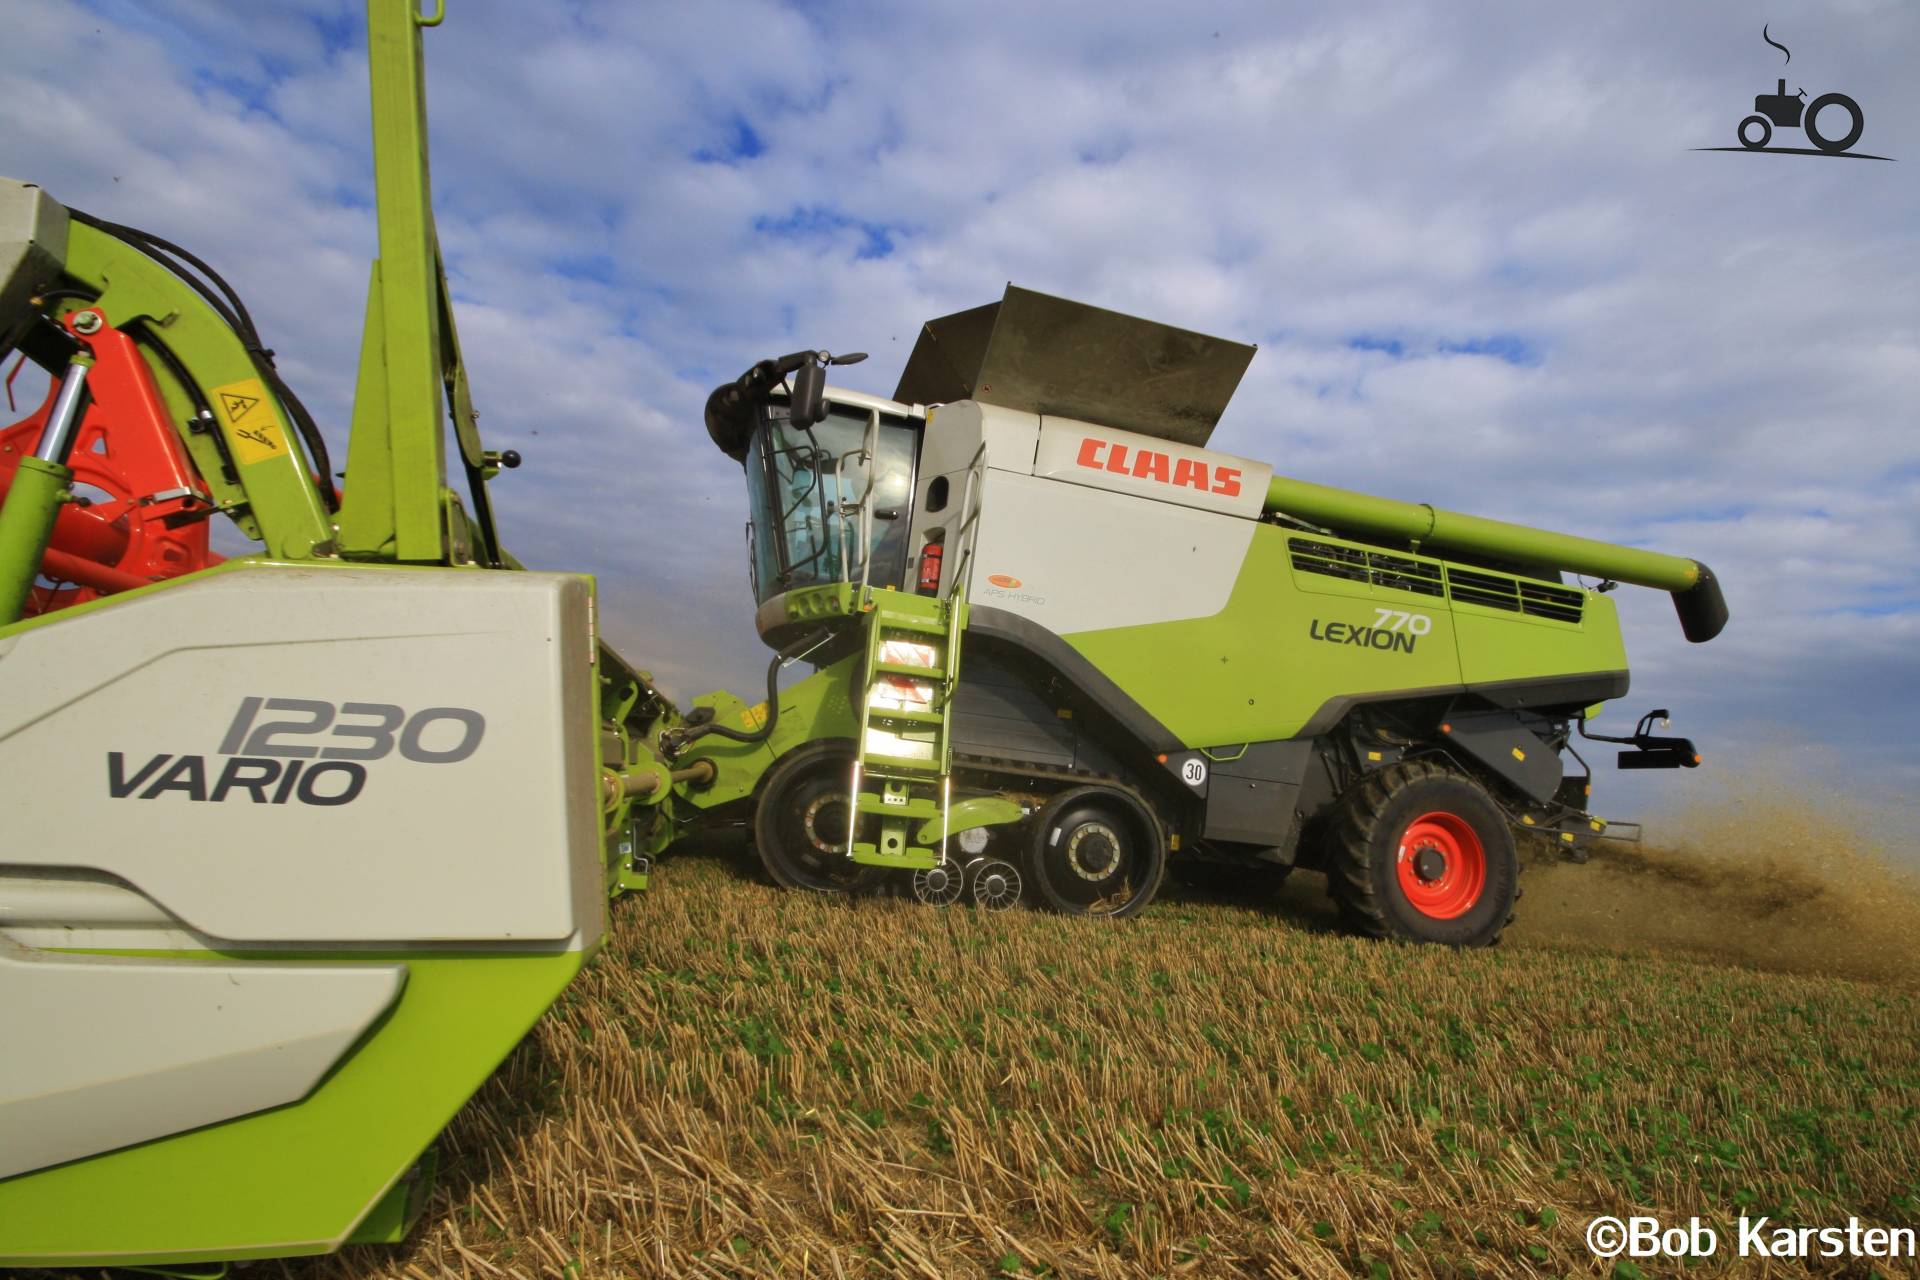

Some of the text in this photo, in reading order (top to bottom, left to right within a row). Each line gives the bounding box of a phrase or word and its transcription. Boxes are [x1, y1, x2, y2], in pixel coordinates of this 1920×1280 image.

[1077, 438, 1242, 497] CLAAS
[1310, 619, 1416, 654] LEXION
[1373, 608, 1432, 636] 770
[217, 696, 486, 764] 1230
[107, 751, 367, 807] VARIO
[1186, 763, 1202, 781] 30
